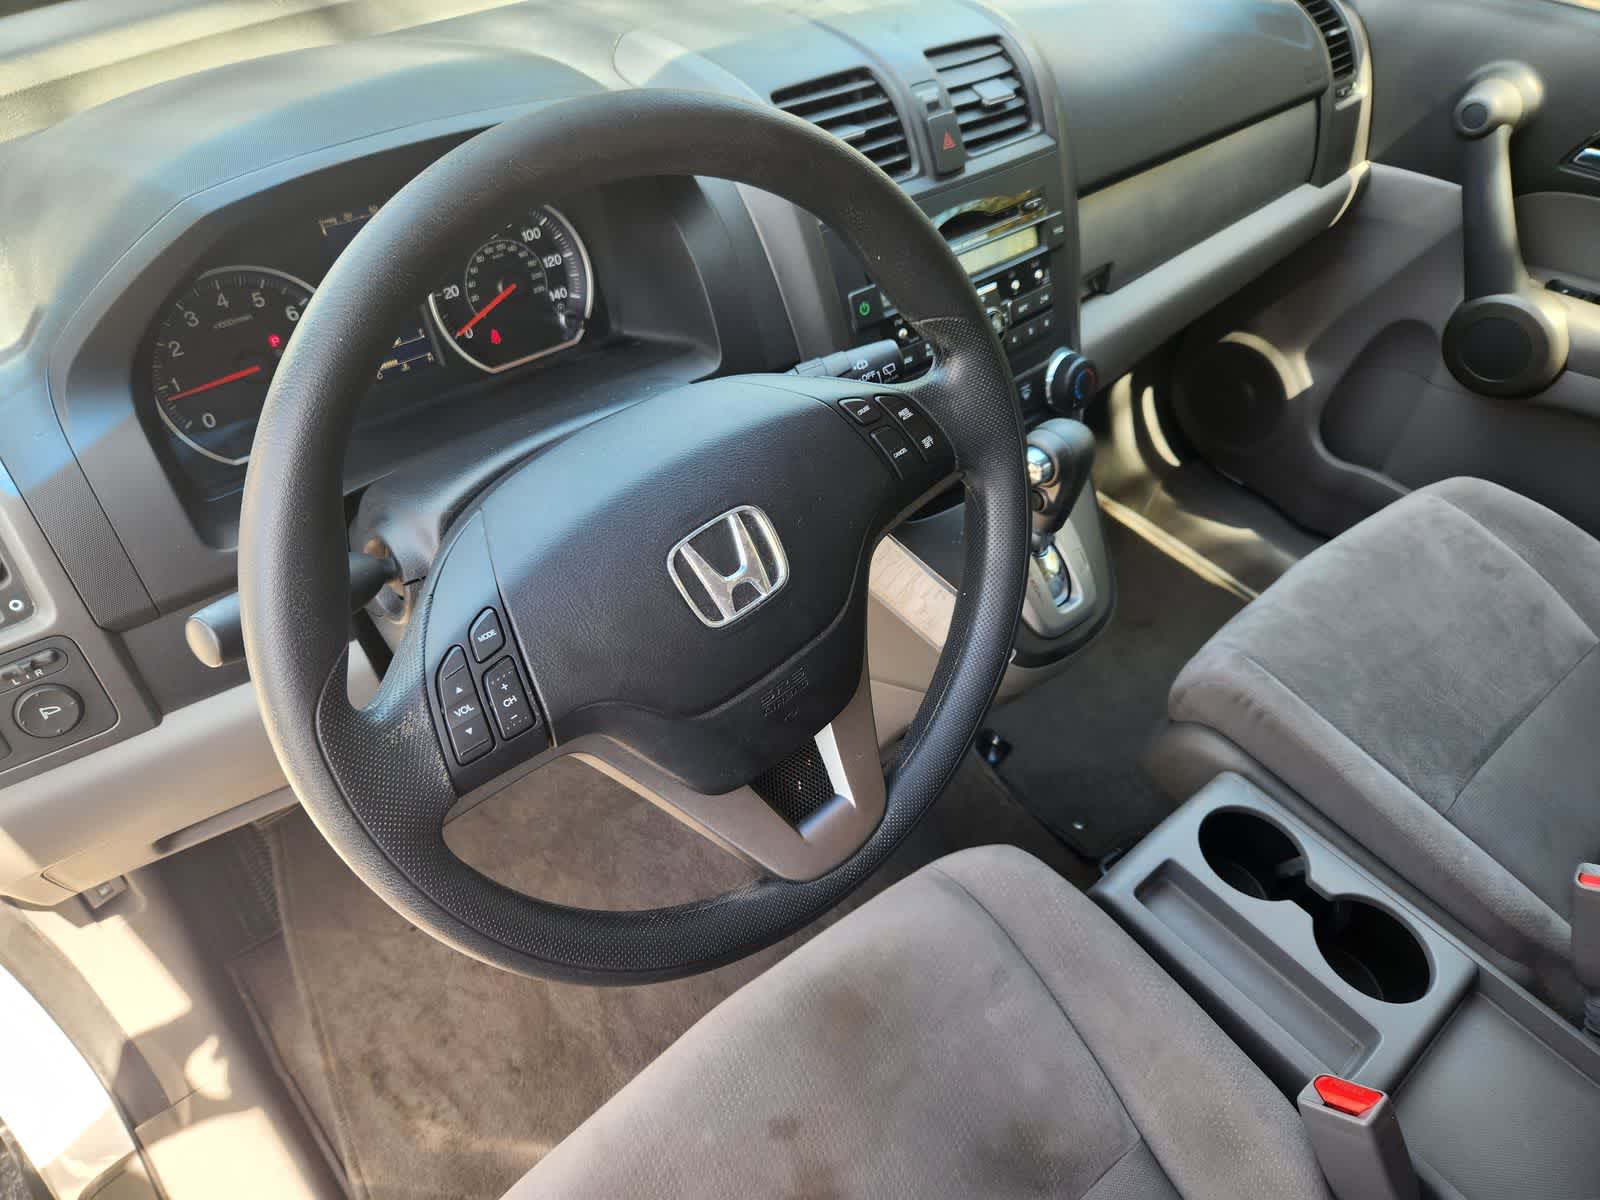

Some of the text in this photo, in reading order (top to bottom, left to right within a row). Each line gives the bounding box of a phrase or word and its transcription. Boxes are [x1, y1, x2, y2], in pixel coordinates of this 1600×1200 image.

[521, 227, 542, 242] 100
[543, 254, 562, 270] 120
[251, 292, 266, 308] 5
[443, 285, 460, 300] 20
[548, 287, 568, 302] 140
[217, 293, 229, 309] 4
[184, 311, 200, 328] 3
[285, 305, 300, 321] 6
[464, 328, 474, 339] 0
[168, 341, 184, 358] 2
[861, 370, 877, 382] OFF
[171, 377, 182, 392] 1
[202, 413, 216, 429] 0
[477, 629, 497, 642] MODE
[12, 668, 45, 686] L R
[503, 695, 518, 708] CH
[453, 704, 475, 718] VOL
